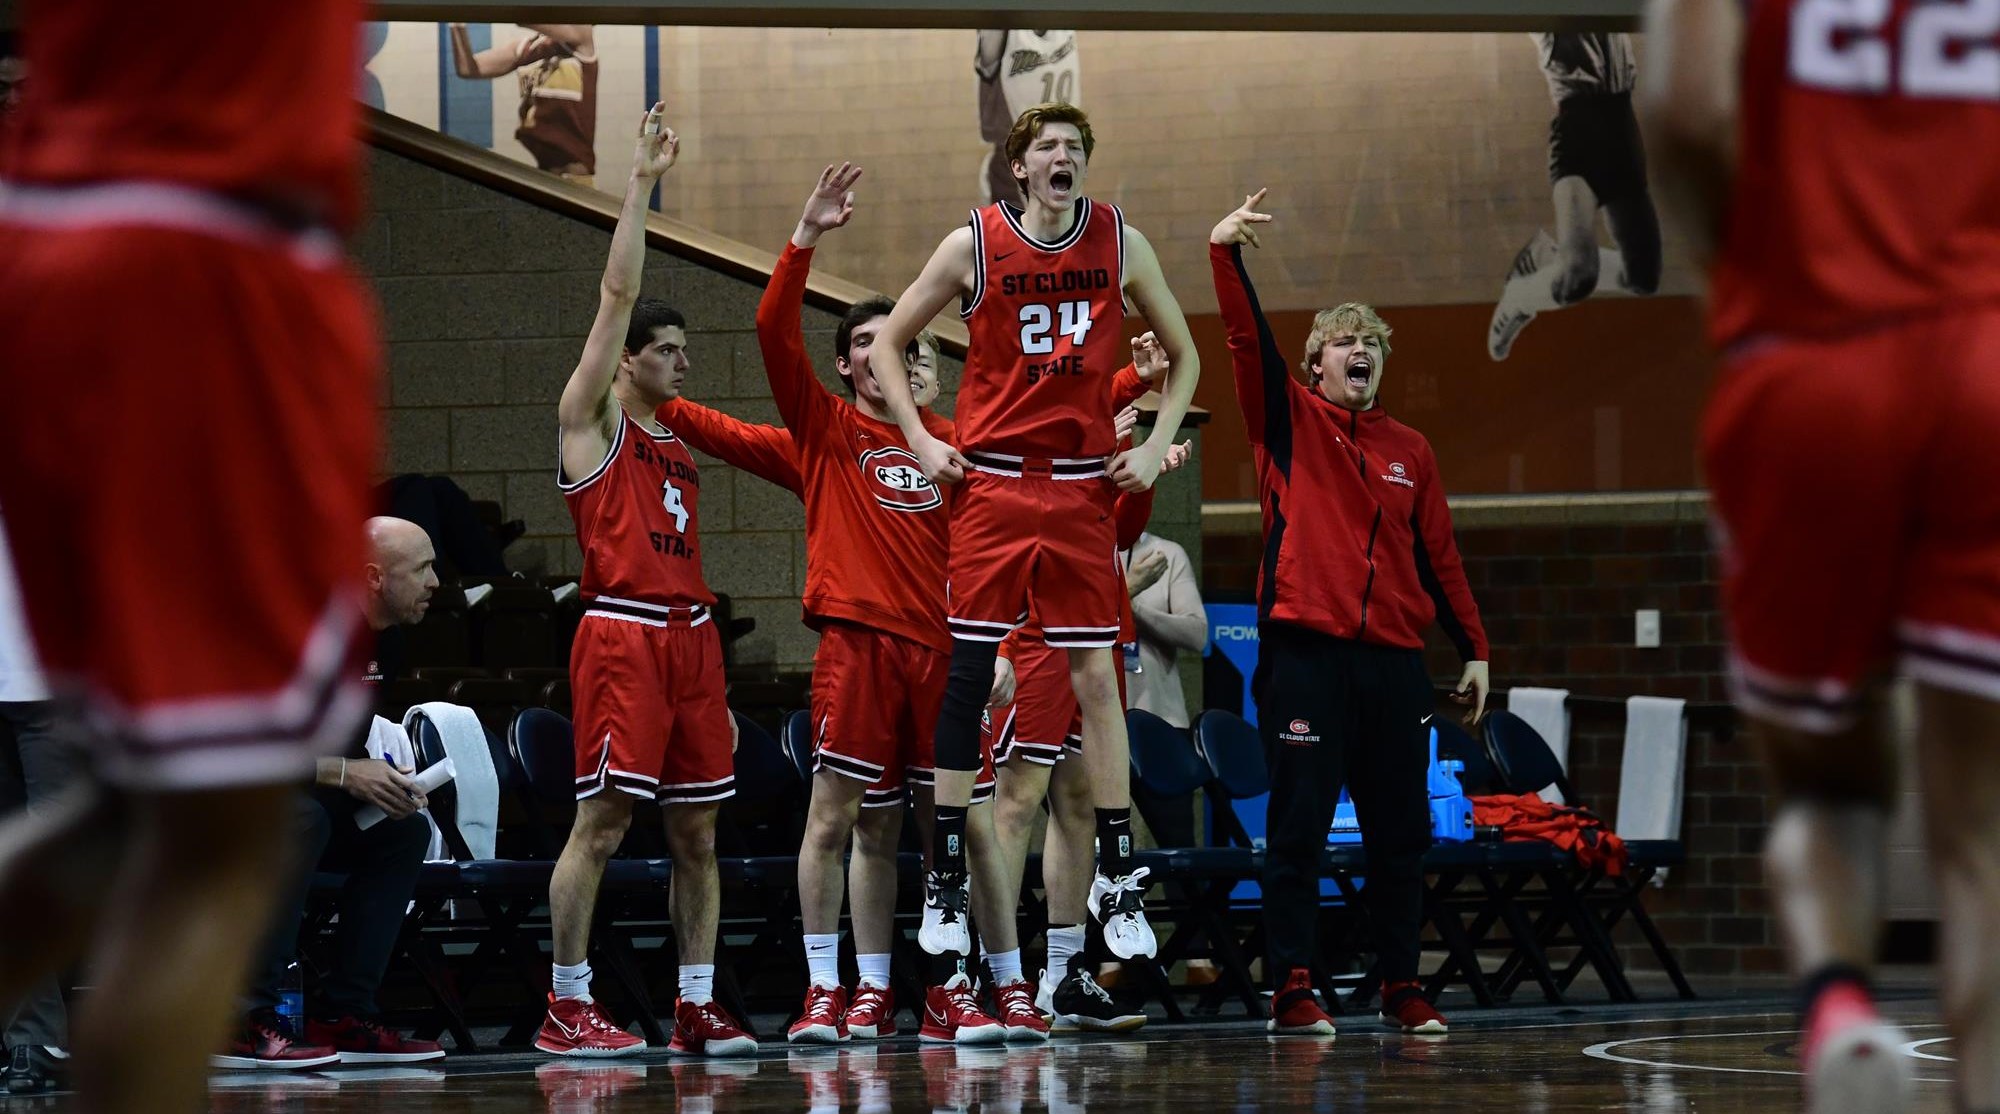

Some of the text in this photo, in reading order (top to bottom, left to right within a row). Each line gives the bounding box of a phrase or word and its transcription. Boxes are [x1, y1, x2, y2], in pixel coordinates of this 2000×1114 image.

[1041, 69, 1073, 104] 10
[1034, 268, 1109, 294] CLOUD
[1019, 299, 1093, 356] 24
[1027, 355, 1084, 386] STATE
[661, 479, 690, 534] 4
